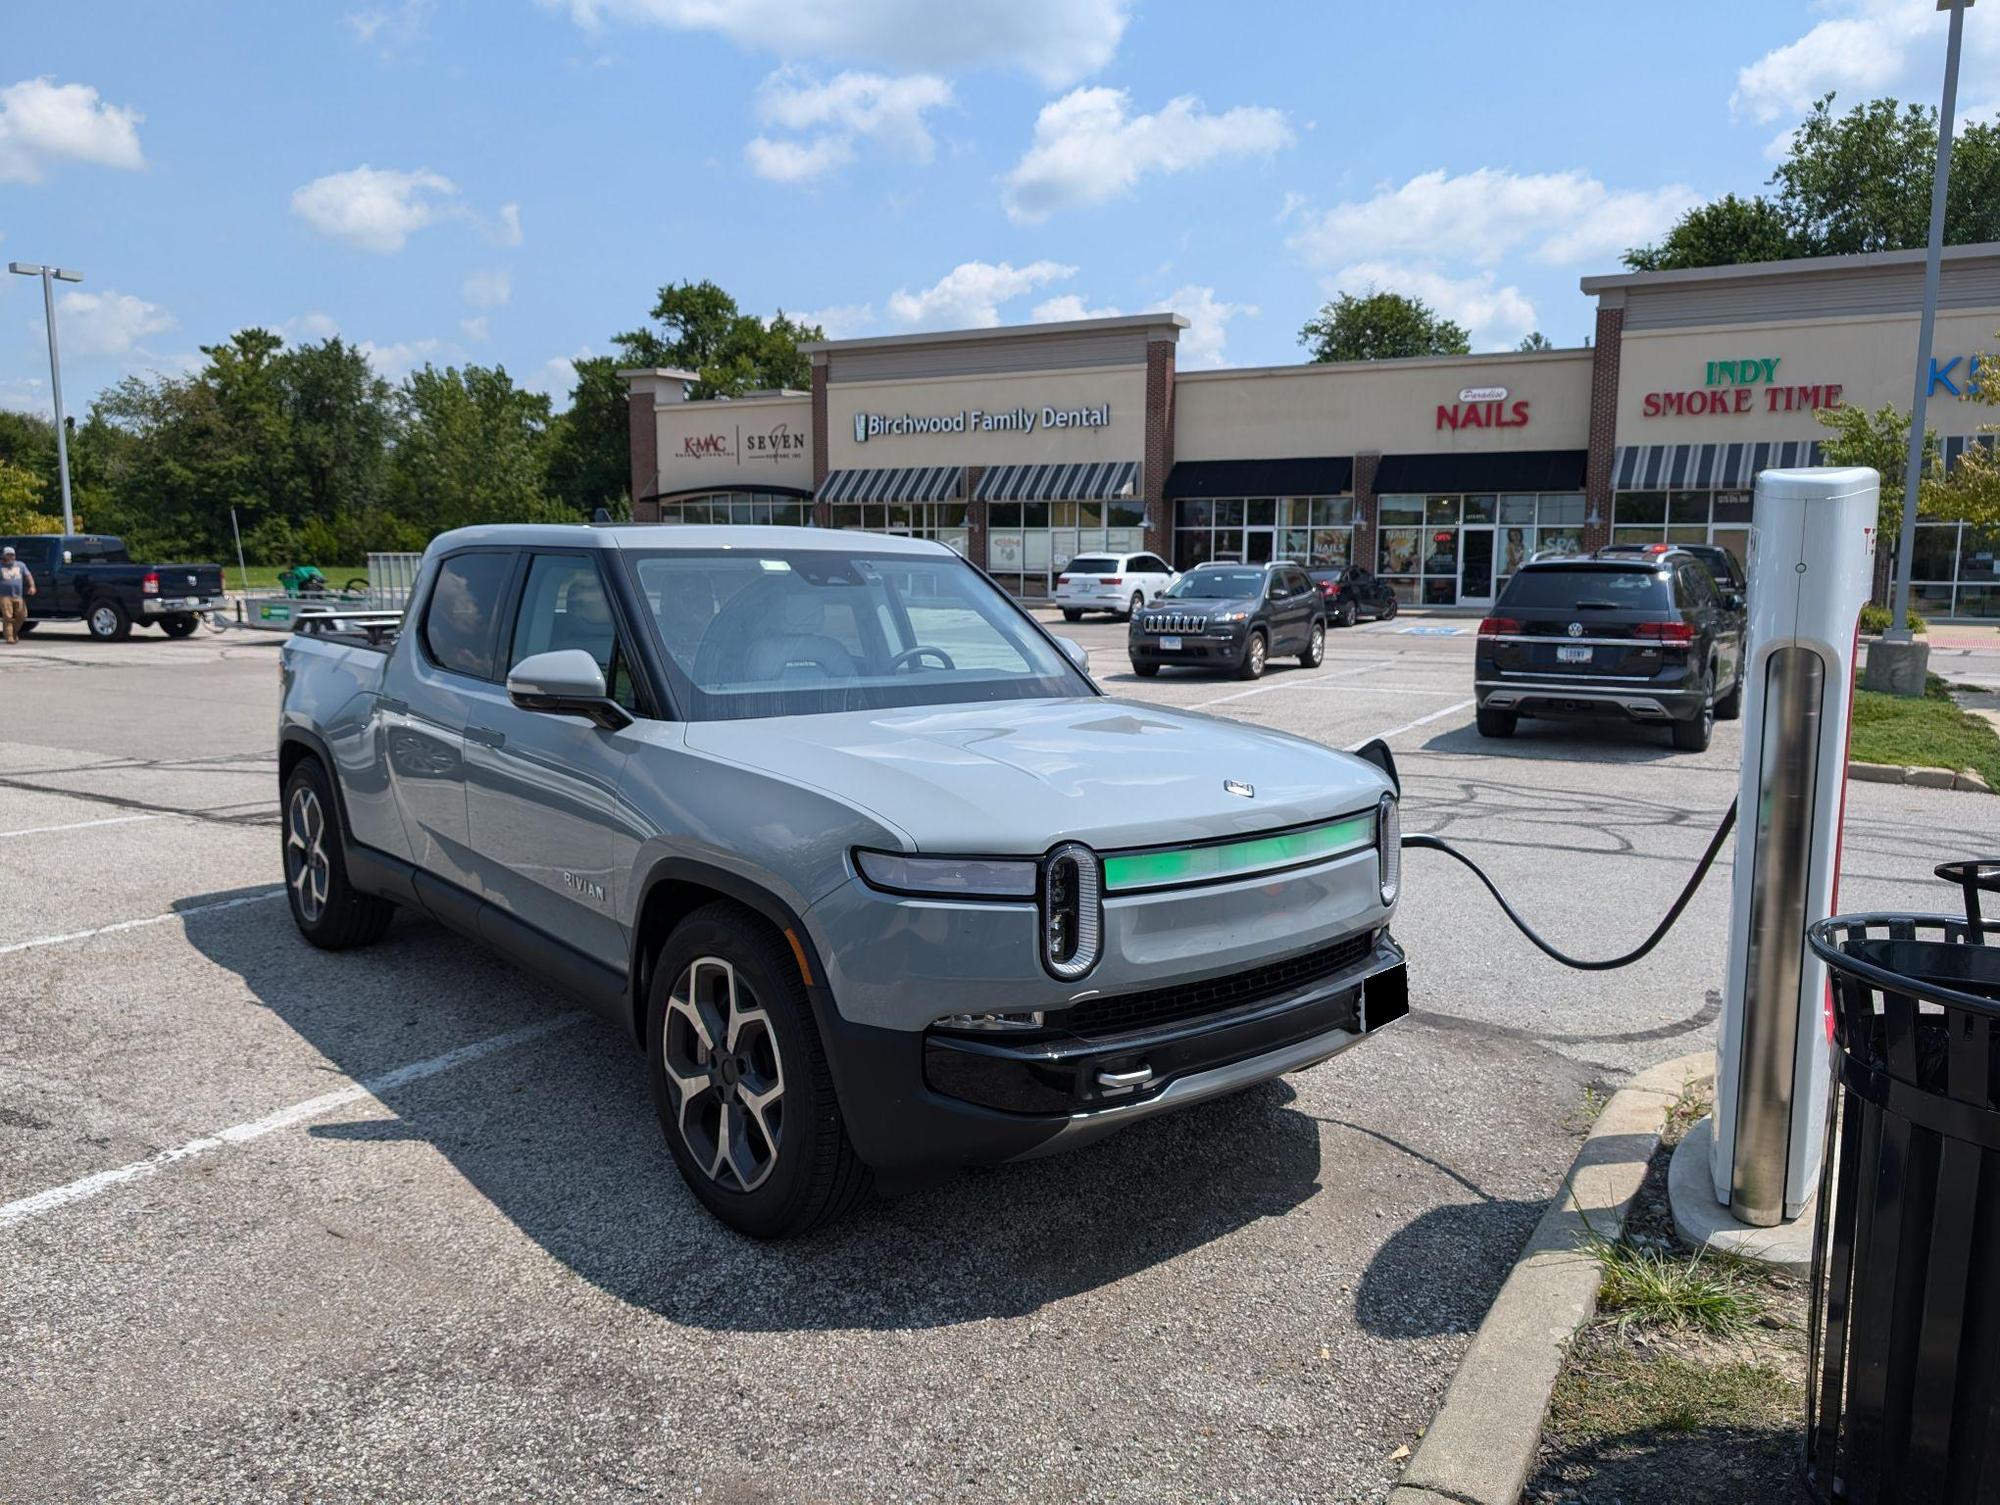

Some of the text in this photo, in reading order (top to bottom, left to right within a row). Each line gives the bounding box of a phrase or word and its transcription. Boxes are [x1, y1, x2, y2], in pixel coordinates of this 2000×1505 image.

[1704, 358, 1781, 386] INDY
[1643, 384, 1843, 417] SMOKE TIME
[867, 404, 1109, 436] Birchwood Family Dental
[1436, 401, 1529, 431] NAILS
[747, 433, 804, 451] SEVEN
[1314, 543, 1345, 553] NAILS
[564, 871, 605, 901] RIVIAN
